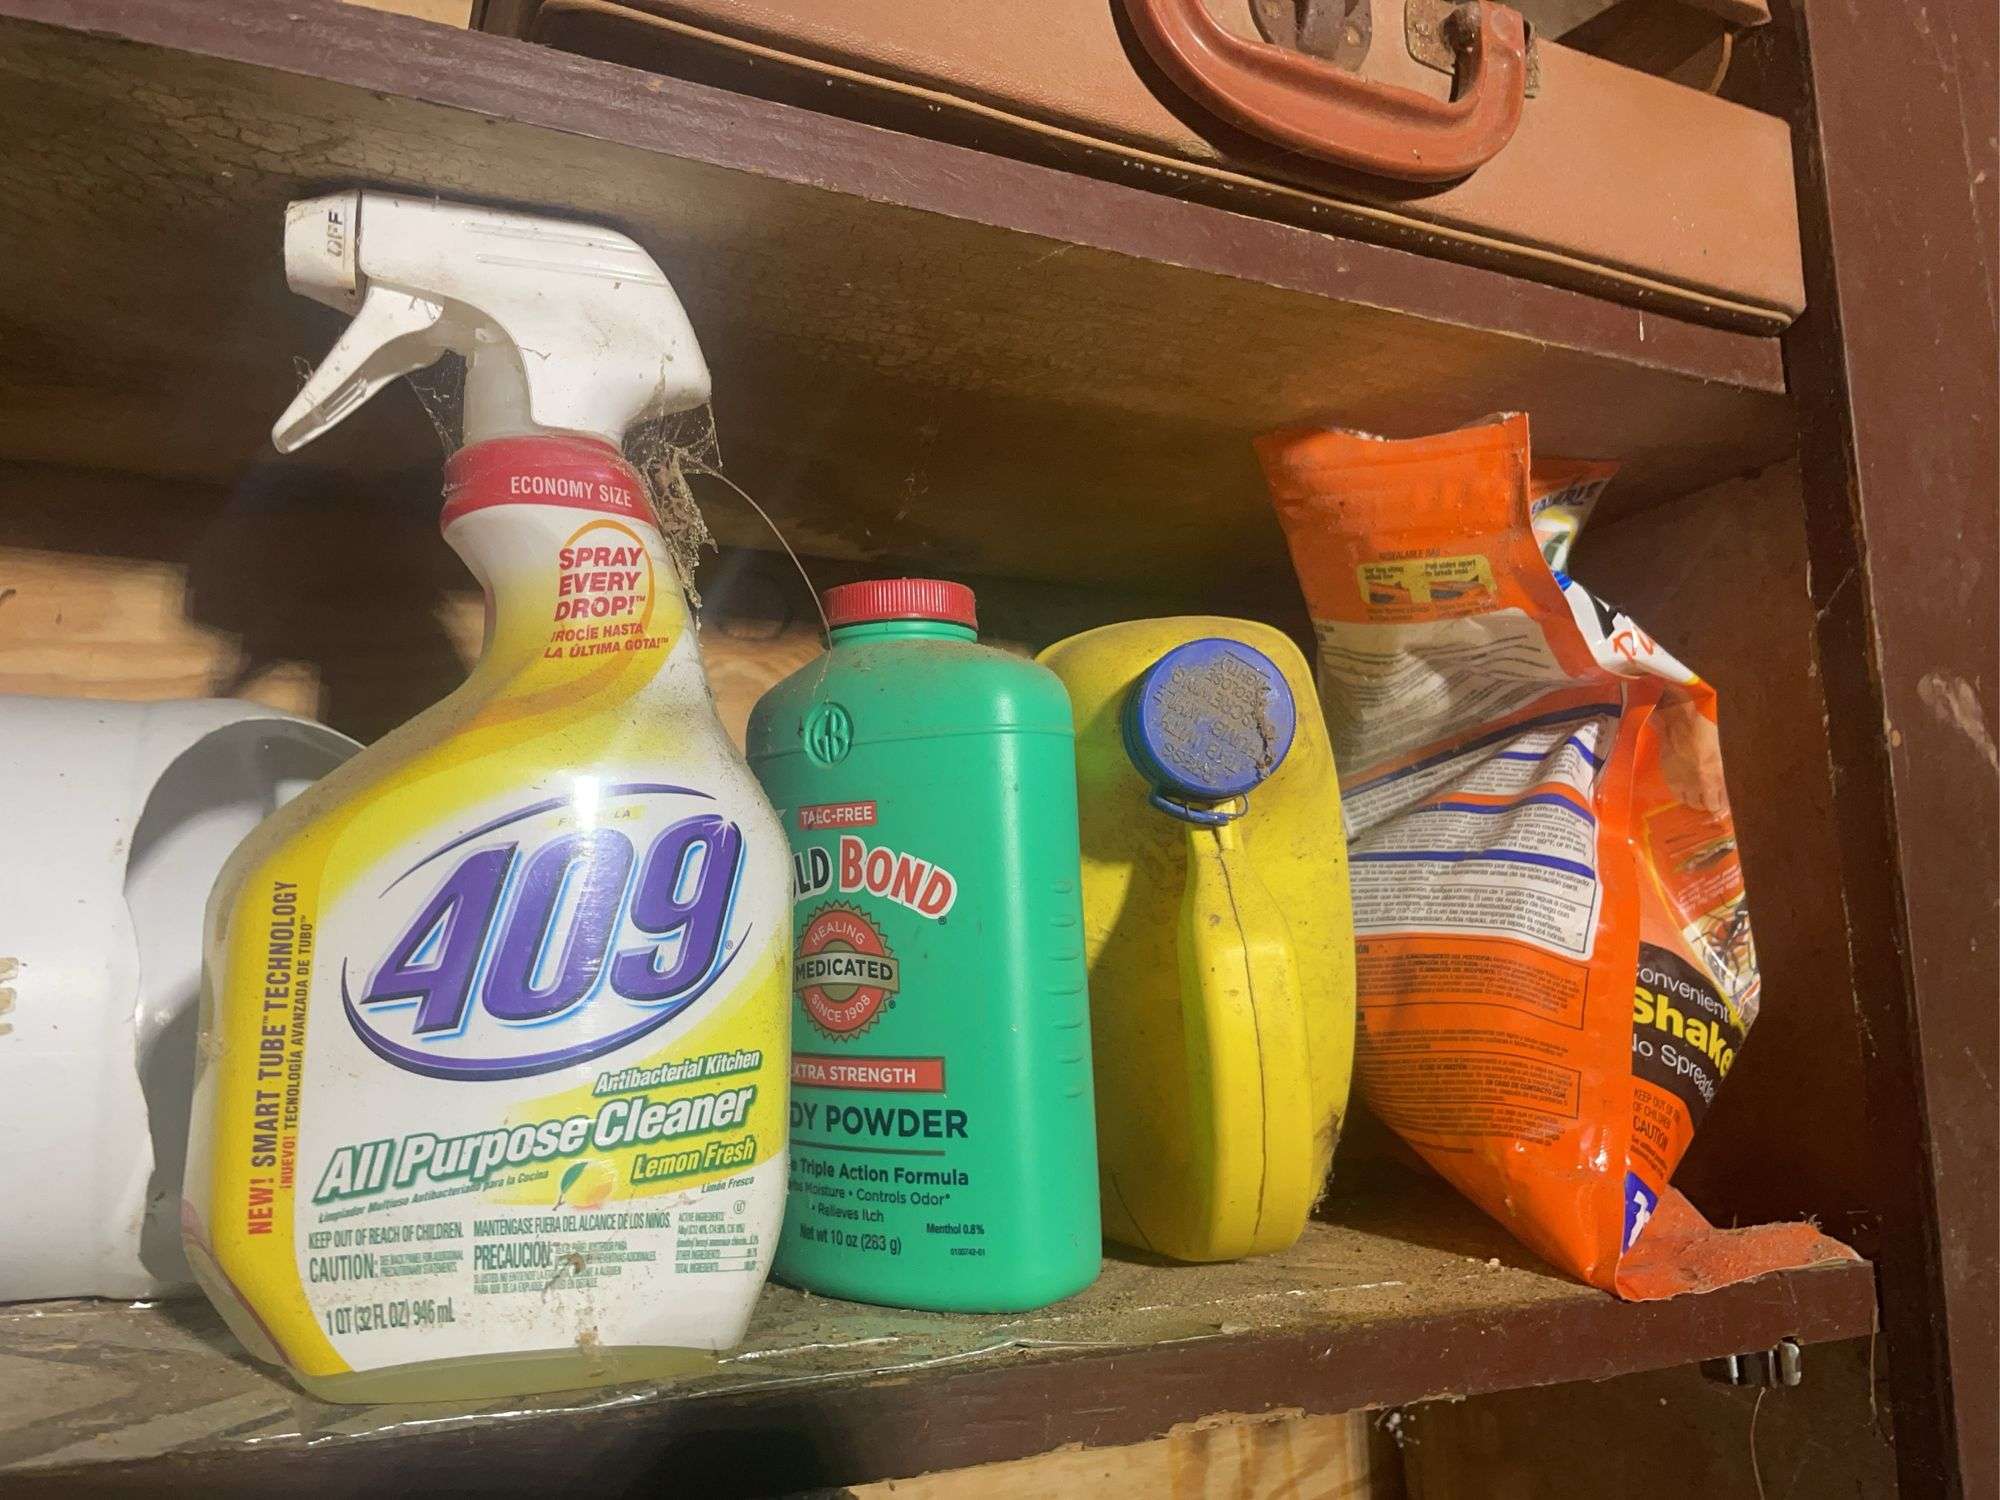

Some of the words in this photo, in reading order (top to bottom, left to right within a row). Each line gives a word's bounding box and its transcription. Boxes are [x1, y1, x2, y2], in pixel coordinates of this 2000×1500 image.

[326, 210, 345, 257] OFF
[511, 476, 594, 500] ECONOMY
[599, 484, 633, 508] SIZE
[559, 547, 643, 569] SPRAY
[558, 572, 642, 596] EVERY
[603, 623, 644, 639] HASTA
[543, 647, 564, 659] LA
[791, 848, 832, 900] LD
[263, 880, 299, 1011] TECHNOLOGY
[811, 920, 866, 946] HEALING
[299, 956, 310, 971] DE
[794, 957, 894, 981] MEDICATED
[291, 973, 309, 1043] AVANZADA
[811, 994, 842, 1023] SINCE
[845, 994, 872, 1021] 1908
[1636, 965, 1729, 1024] onvenient
[592, 1057, 705, 1097] Antibacterial
[705, 1049, 763, 1080] Kitchen
[791, 1063, 827, 1081] XTRA
[829, 1066, 917, 1084] STRENGTH
[252, 1089, 280, 1169] SMART
[790, 1102, 818, 1131] DY
[826, 1104, 969, 1139] POWDER
[312, 1138, 396, 1204] All
[393, 1118, 598, 1187] Purpose
[594, 1086, 756, 1149] Cleaner
[629, 1149, 702, 1186] Lemon
[702, 1135, 757, 1168] Fresh
[799, 1157, 836, 1178] Triple
[839, 1163, 889, 1183] Action
[894, 1166, 969, 1186] Formula
[517, 1169, 550, 1184] Cocina
[728, 1175, 755, 1189] Fresco
[247, 1177, 275, 1235] NEW!
[805, 1182, 846, 1199] Moisture
[856, 1188, 907, 1204] Controls
[473, 1217, 534, 1238] MANTENGASE
[535, 1215, 561, 1235] FUERA
[562, 1214, 578, 1233] DEL
[578, 1213, 617, 1233] ALCANCE
[617, 1212, 628, 1230] DE
[629, 1212, 645, 1230] LOS
[817, 1202, 859, 1220] Relieves
[862, 1208, 884, 1223] Itch
[308, 1230, 333, 1250] KEEP
[334, 1228, 354, 1248] OUT
[355, 1228, 368, 1247] OF
[368, 1225, 400, 1245] REACH
[402, 1223, 415, 1242] OF
[416, 1220, 464, 1241] CHILDREN.
[800, 1223, 815, 1240] Net
[816, 1228, 828, 1243] wt
[831, 1230, 844, 1246] 10
[845, 1235, 859, 1248] oz
[860, 1233, 887, 1252] (283
[889, 1236, 902, 1256] g)
[926, 1223, 962, 1235] Menthol
[309, 1252, 380, 1284] CAUTION:
[326, 1309, 334, 1336] 1
[336, 1306, 352, 1335] QT
[354, 1304, 373, 1335] (32
[373, 1303, 388, 1331] FL
[390, 1299, 410, 1329] OZ)
[413, 1299, 435, 1326] 946
[436, 1296, 456, 1324] mL
